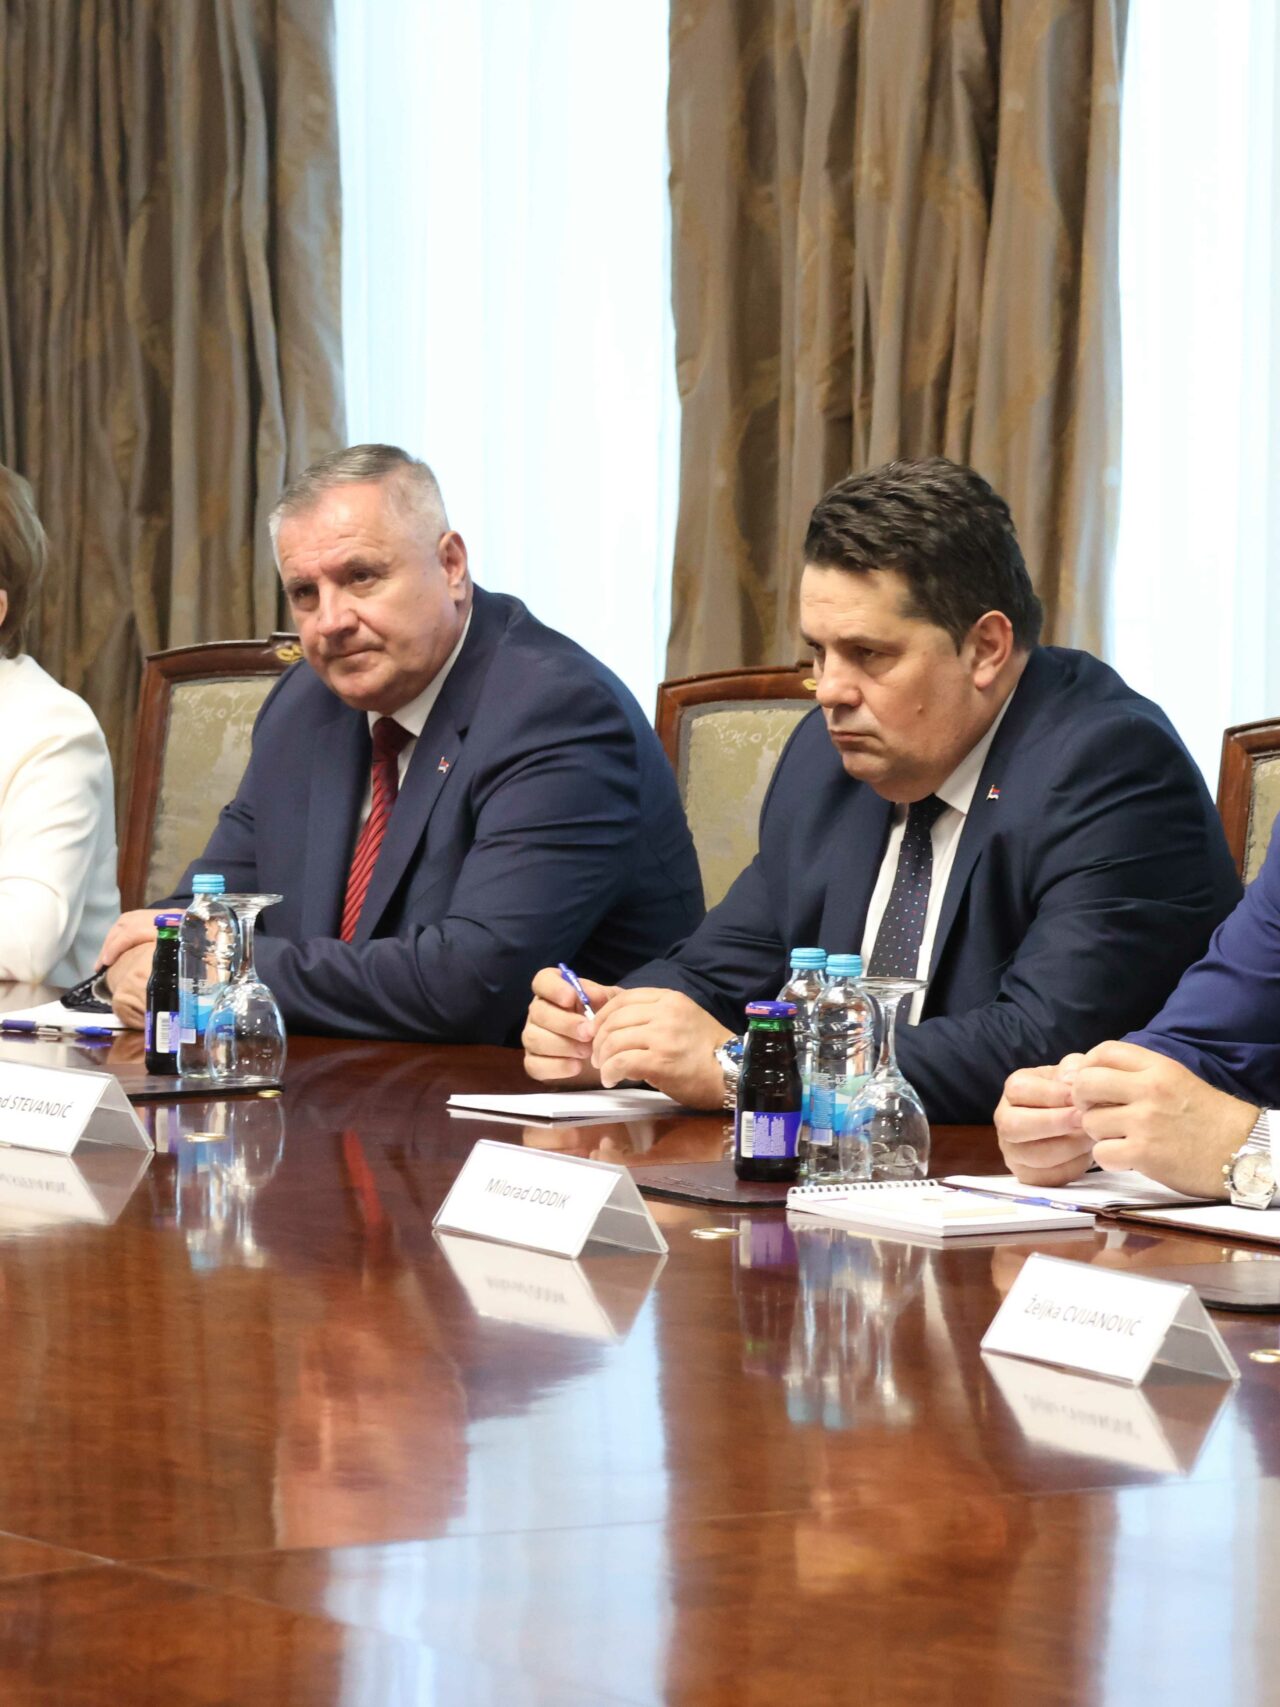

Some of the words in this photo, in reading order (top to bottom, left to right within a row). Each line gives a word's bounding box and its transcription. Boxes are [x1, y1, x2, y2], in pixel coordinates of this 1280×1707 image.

[9, 1096, 74, 1118] STEVANDIĆ
[486, 1178, 532, 1200] Milorad
[530, 1188, 571, 1209] DODIK
